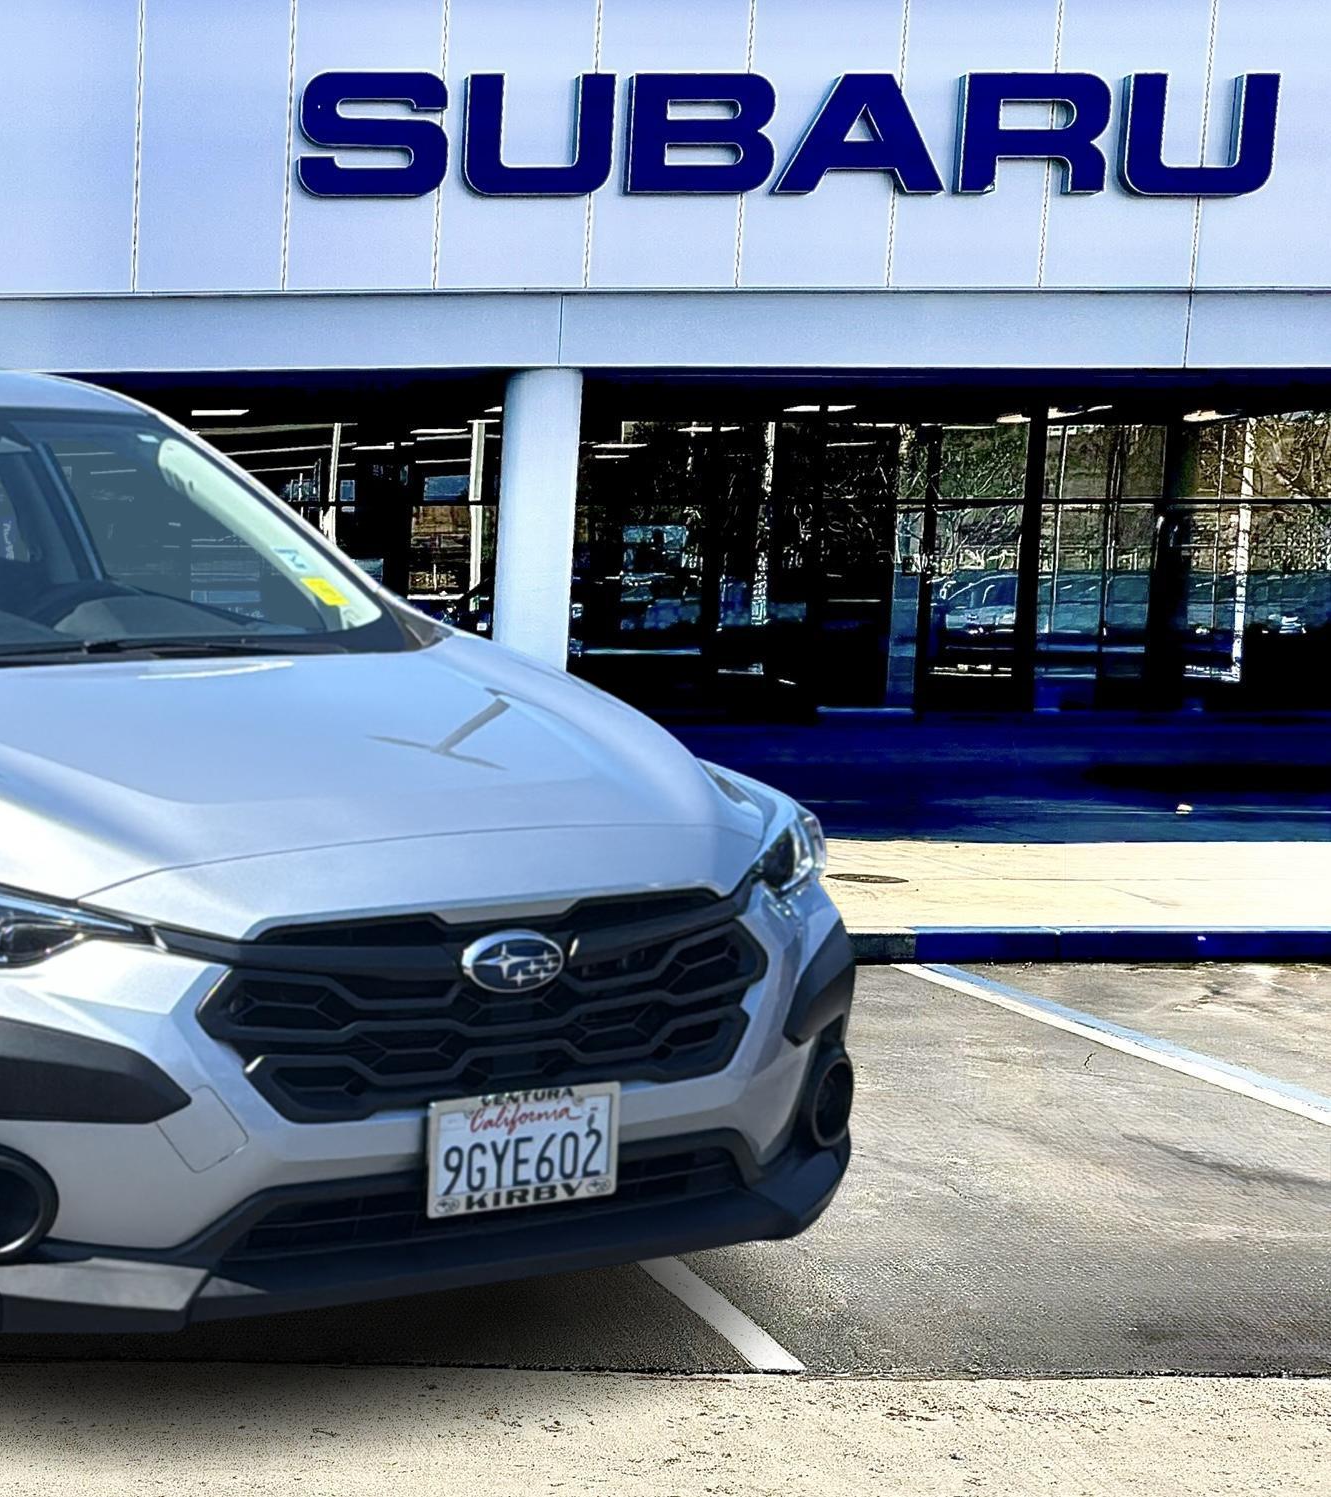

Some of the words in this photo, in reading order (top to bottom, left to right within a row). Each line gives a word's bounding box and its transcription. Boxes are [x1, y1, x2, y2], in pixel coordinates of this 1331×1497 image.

[297, 71, 1281, 197] SUBARU
[481, 1087, 575, 1107] VENTURA
[469, 1106, 582, 1135] California
[441, 1128, 603, 1196] 9GYE602
[464, 1181, 583, 1211] KIRBY
